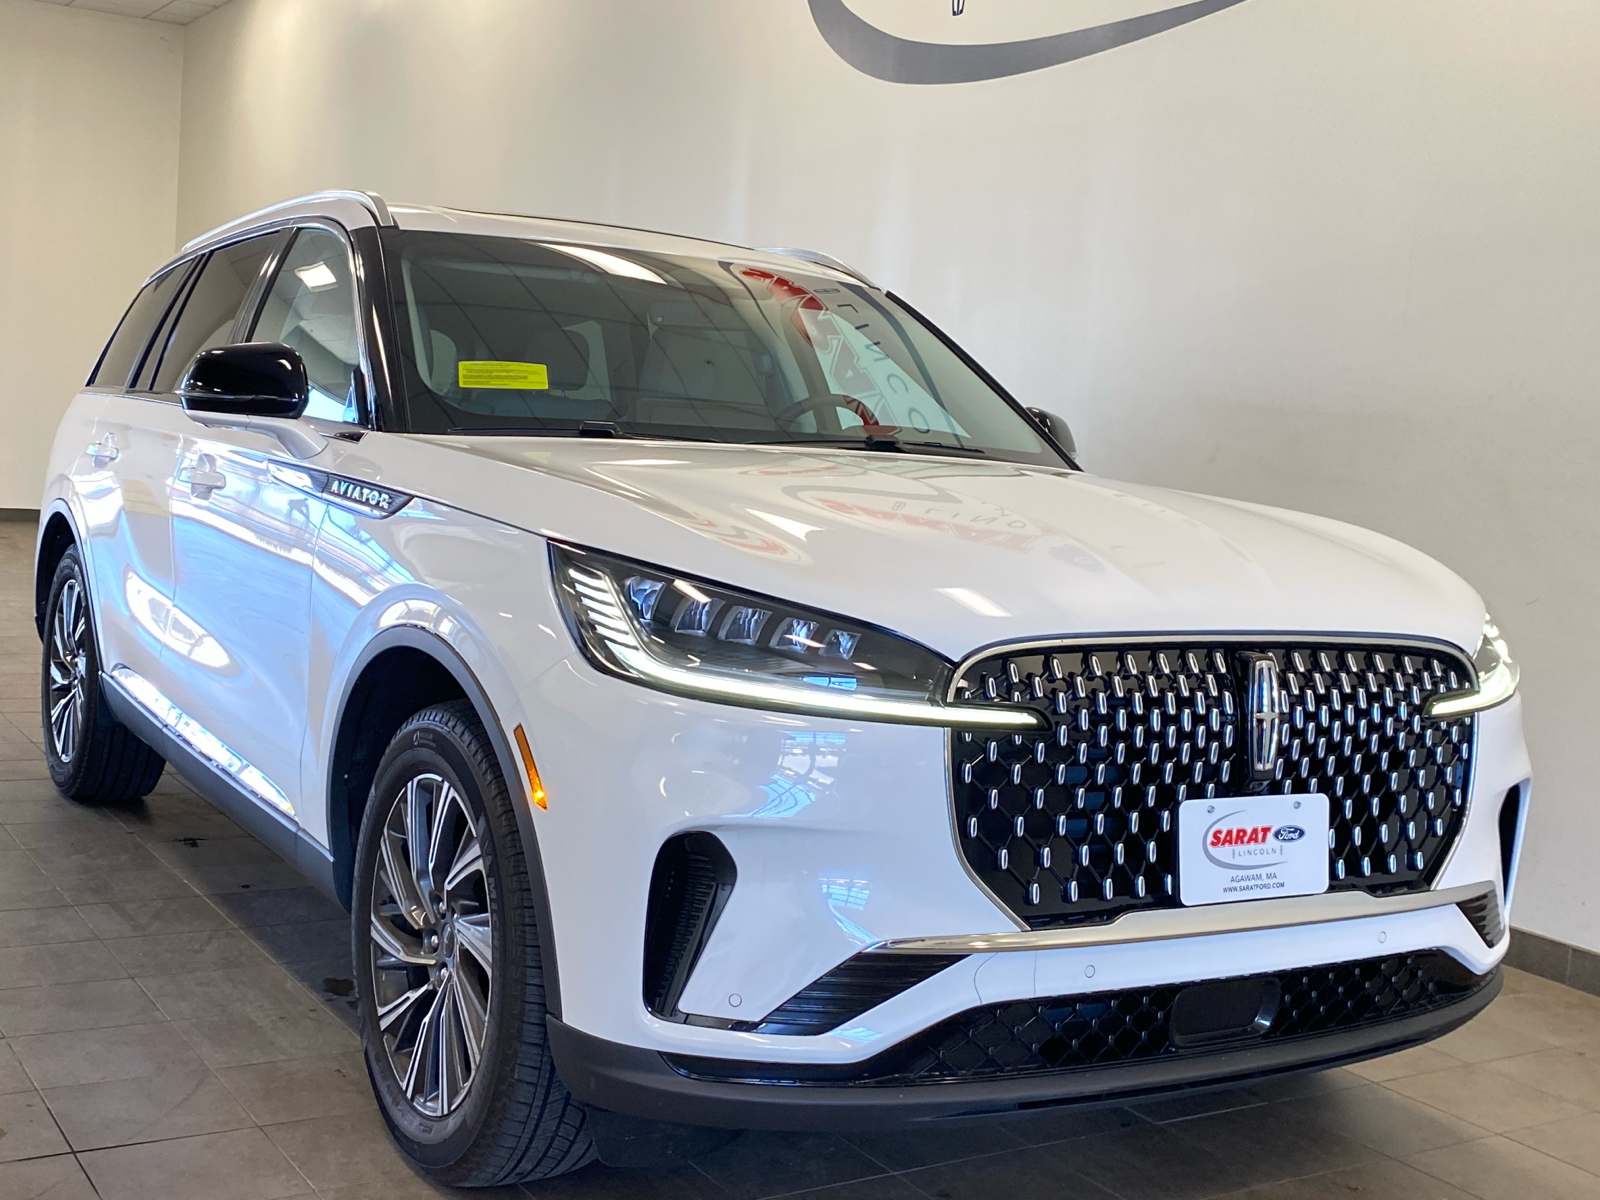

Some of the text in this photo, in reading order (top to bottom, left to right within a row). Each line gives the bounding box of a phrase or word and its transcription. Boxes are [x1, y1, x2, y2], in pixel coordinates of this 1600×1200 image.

[331, 480, 392, 509] AVIATOR
[1210, 826, 1273, 847] SARAT
[1239, 848, 1276, 857] LINCOLN
[1230, 872, 1278, 884] AGAWAM, MA
[1223, 882, 1285, 893] WWW.SARATFORD.COM
